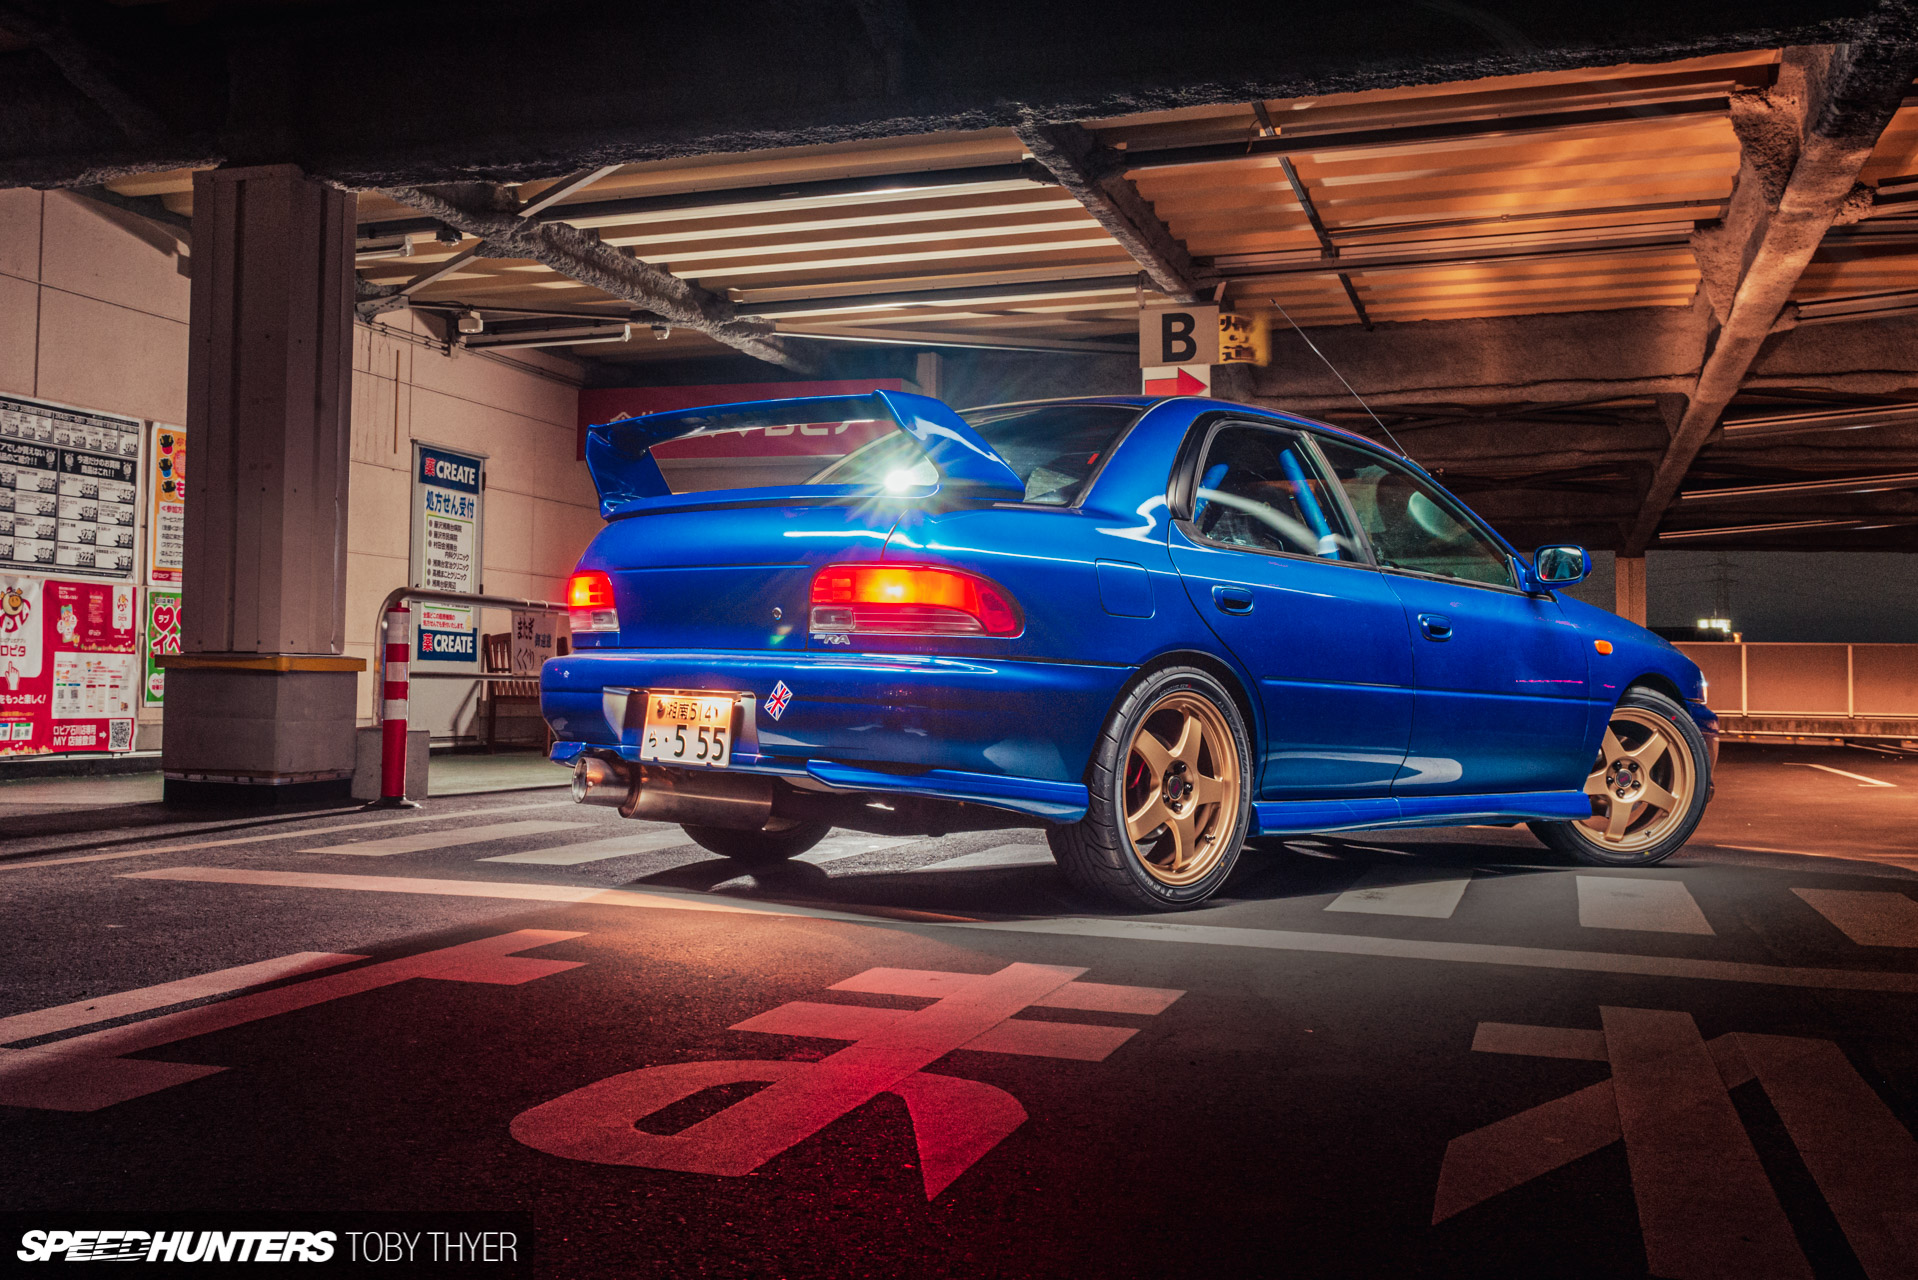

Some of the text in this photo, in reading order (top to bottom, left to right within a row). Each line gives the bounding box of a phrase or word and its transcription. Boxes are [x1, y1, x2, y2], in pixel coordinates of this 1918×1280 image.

[1162, 312, 1197, 363] B
[436, 460, 476, 485] CREATE
[426, 490, 474, 519] 処方せん受付
[433, 634, 473, 654] CREATE
